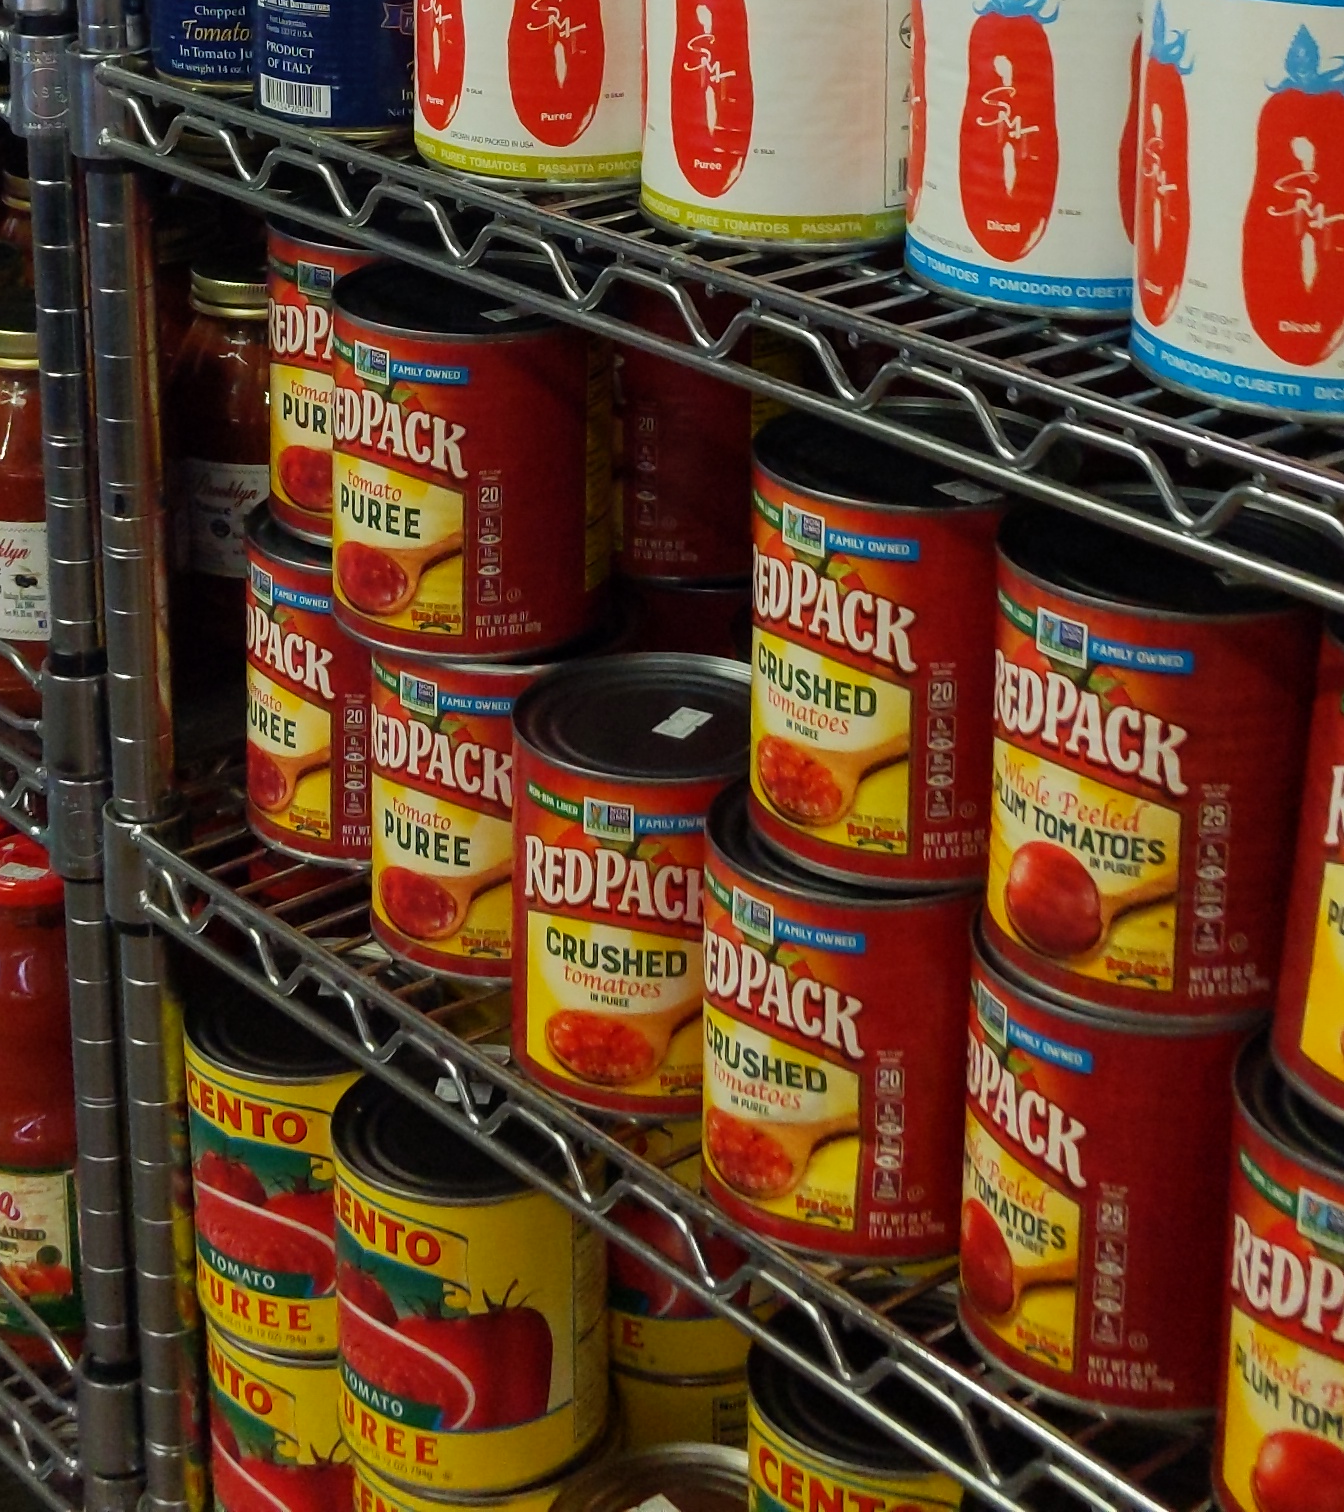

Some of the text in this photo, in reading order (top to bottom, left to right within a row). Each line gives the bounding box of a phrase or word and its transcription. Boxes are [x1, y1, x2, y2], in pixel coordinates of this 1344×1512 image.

[194, 5, 245, 20] Chopped
[180, 46, 236, 62] In Tomato
[267, 40, 314, 58] PRODUCT
[268, 58, 312, 75] OF ITALY
[540, 110, 573, 122] Puree
[473, 154, 526, 173] TOMATOES
[694, 159, 722, 170] Puree
[721, 216, 789, 234] TOMATOES
[392, 362, 461, 381] FAMILY OWNED
[1233, 376, 1302, 400] CUBETTI
[347, 470, 402, 501] tomato
[481, 487, 498, 502] 20
[340, 490, 421, 540] PUREE
[829, 532, 910, 556] FAMILY OWNED
[275, 587, 329, 610] FAMILY OWNED
[1092, 642, 1184, 668] FAMILY OWNED
[759, 641, 878, 718] CRUSHED
[932, 682, 952, 702] 20
[441, 695, 510, 711] FAMILY OWNED
[767, 686, 850, 737] tomatoes
[797, 722, 818, 740] PUREE
[392, 796, 451, 831] tomato
[1057, 785, 1139, 833] Peeled
[1203, 806, 1226, 827] 25
[639, 816, 670, 830] FAMILY
[385, 814, 471, 866] PUREE
[1032, 807, 1167, 867] TOMATOES
[1102, 859, 1141, 877] PUREE
[778, 920, 857, 948] FAMILY OWNED
[545, 927, 688, 977] CRUSHED
[562, 963, 662, 1000] tomatoes
[604, 994, 630, 1008] PUREE
[705, 1016, 827, 1093] CRUSHED
[714, 1064, 802, 1111] tomatoes
[878, 1068, 900, 1089] 20
[187, 1076, 309, 1145] CENTO
[985, 1158, 1047, 1219] Peeled
[975, 1177, 1067, 1253] TOMATOES
[210, 1247, 276, 1291] TOMATO
[198, 1267, 312, 1333] PUREE
[1246, 1333, 1317, 1400] Whole
[343, 1369, 403, 1417] TOMATO
